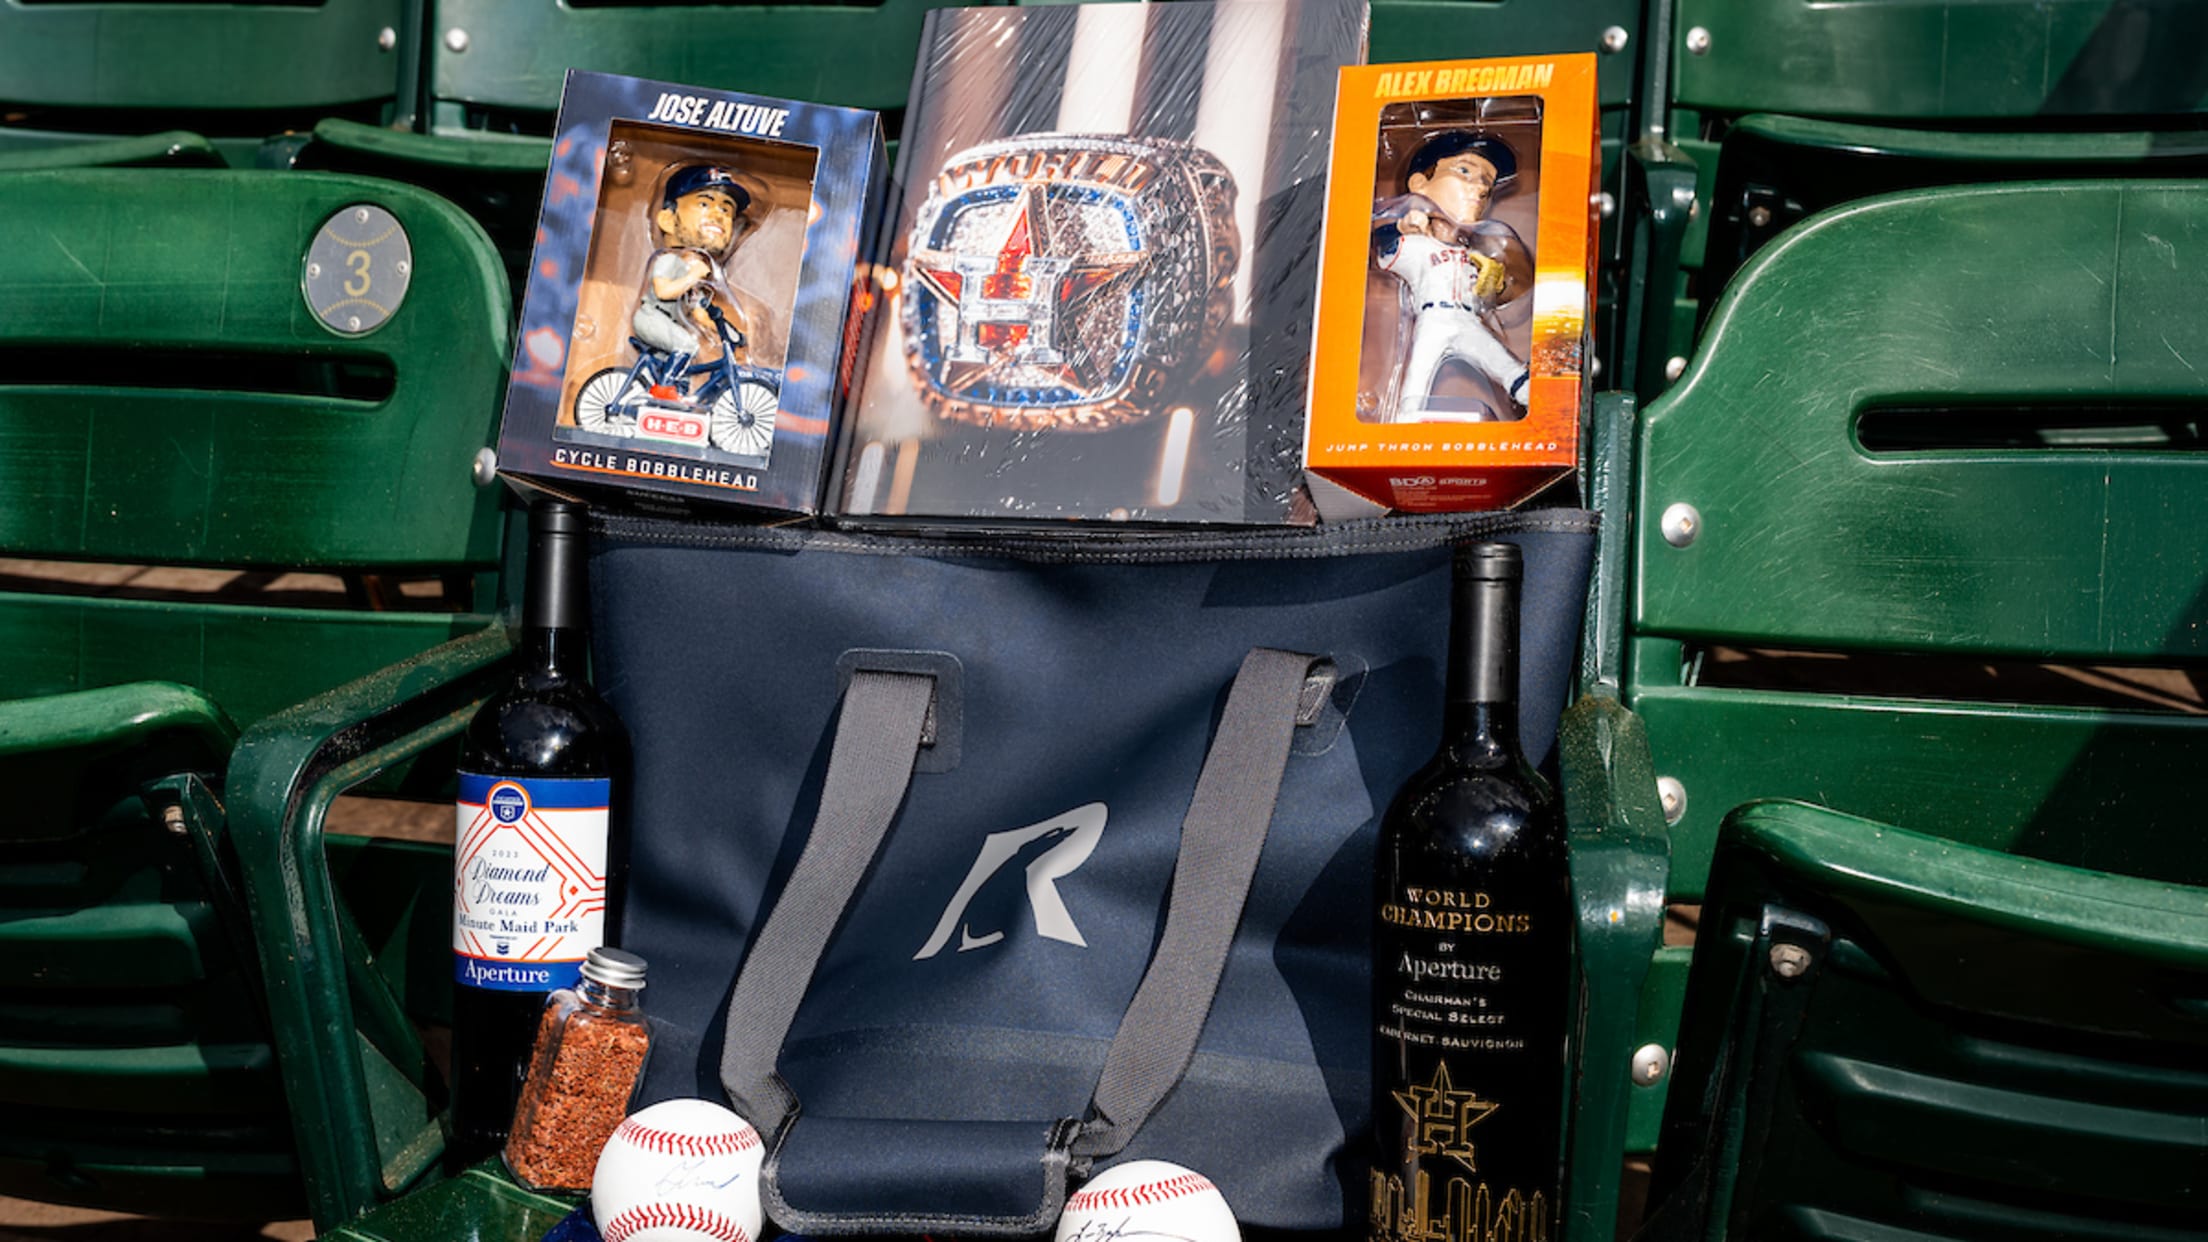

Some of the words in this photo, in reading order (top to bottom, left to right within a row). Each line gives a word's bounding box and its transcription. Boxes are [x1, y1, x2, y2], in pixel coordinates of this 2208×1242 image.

[1375, 70, 1431, 98] ALEX
[1434, 63, 1554, 95] BREGMAN
[648, 92, 709, 126] JOSE
[704, 101, 790, 137] ALTUVE
[344, 249, 372, 297] 3
[1326, 443, 1368, 452] JUMP
[1379, 442, 1433, 451] THROW
[1442, 441, 1557, 451] BOBBLEHEAD
[555, 449, 618, 470] CYCLE
[626, 458, 758, 489] BOBBLEHEAD
[492, 849, 520, 859] 2023
[469, 855, 551, 883] Diamond
[471, 879, 541, 906] Dreams
[1407, 887, 1491, 908] WORLD
[459, 912, 496, 930] Minute
[499, 918, 538, 934] Maid
[544, 921, 579, 934] Park
[489, 907, 518, 917] GALA
[1381, 904, 1531, 933] CHAMPIONS
[1438, 942, 1456, 953] BY
[464, 960, 550, 985] Aperture
[1398, 951, 1501, 982] Aperture
